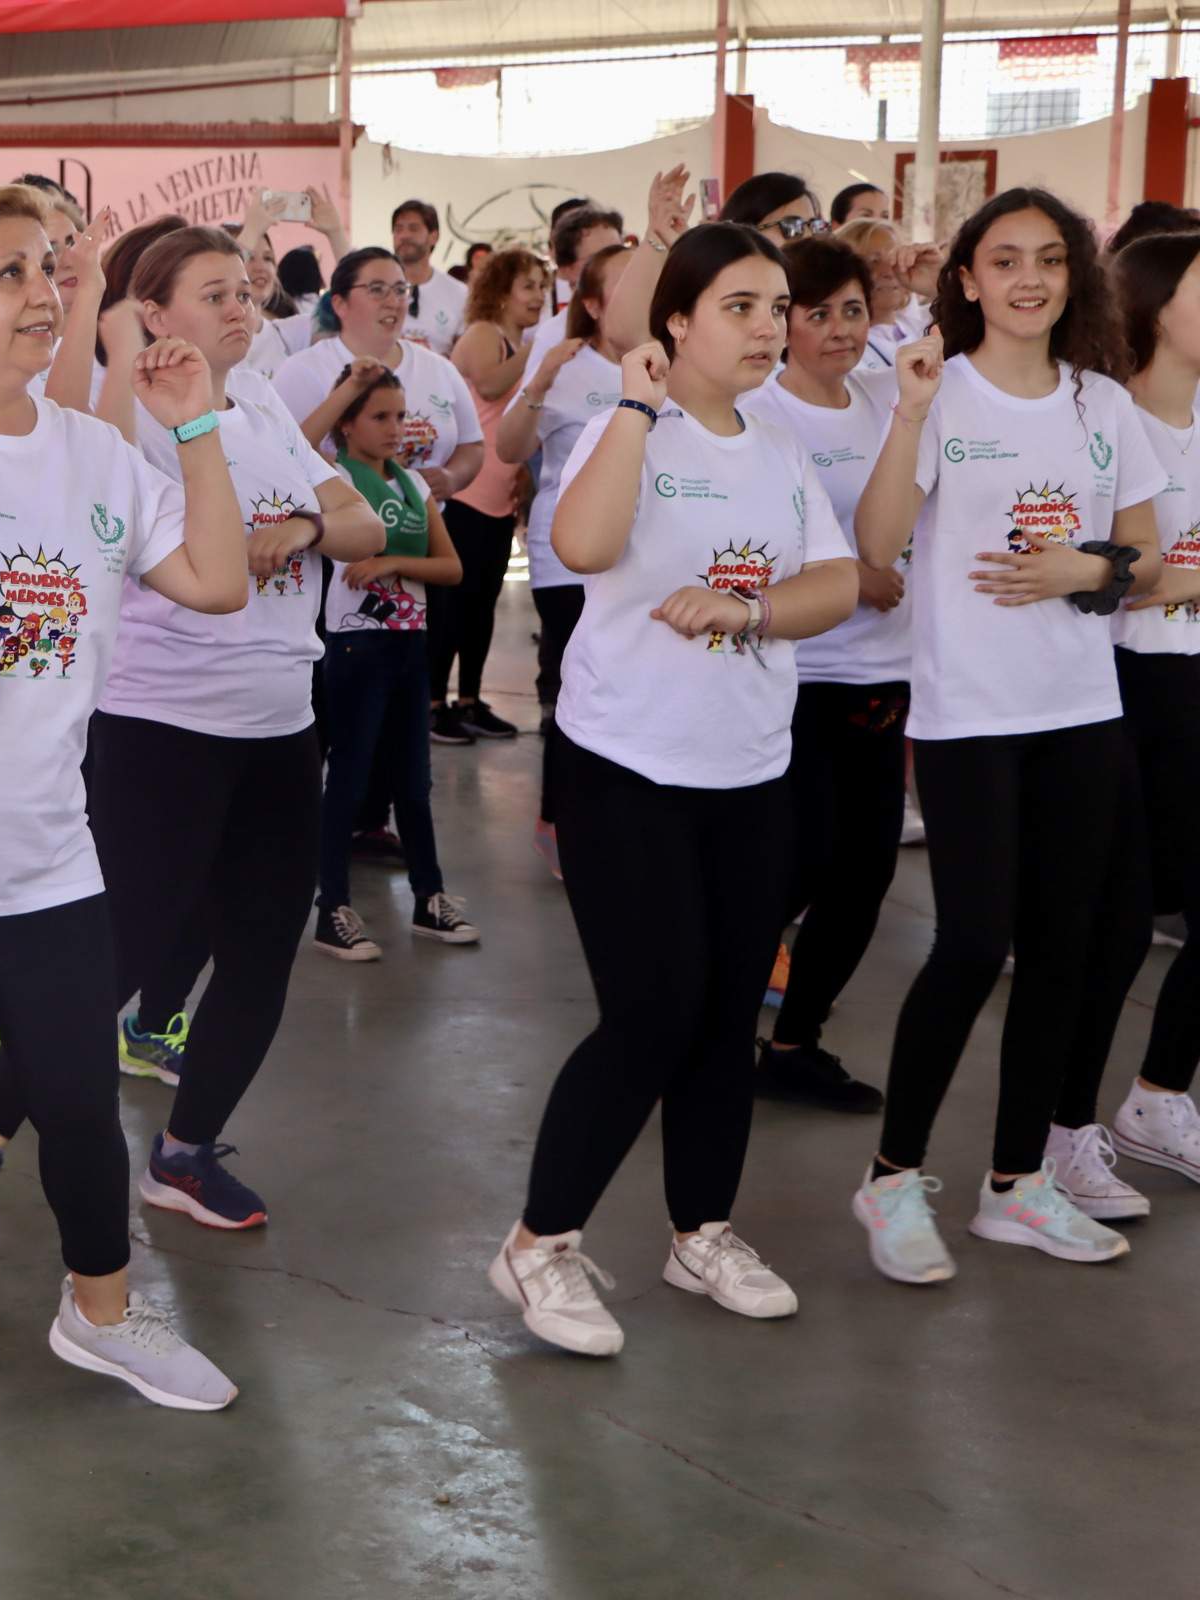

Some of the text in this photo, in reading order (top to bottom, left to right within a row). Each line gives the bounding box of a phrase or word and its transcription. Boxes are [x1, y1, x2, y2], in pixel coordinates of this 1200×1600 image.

[127, 192, 151, 225] LA
[155, 152, 263, 203] VENTANA
[0, 569, 81, 591] PEQUEÑOS
[5, 588, 65, 607] HEROES
